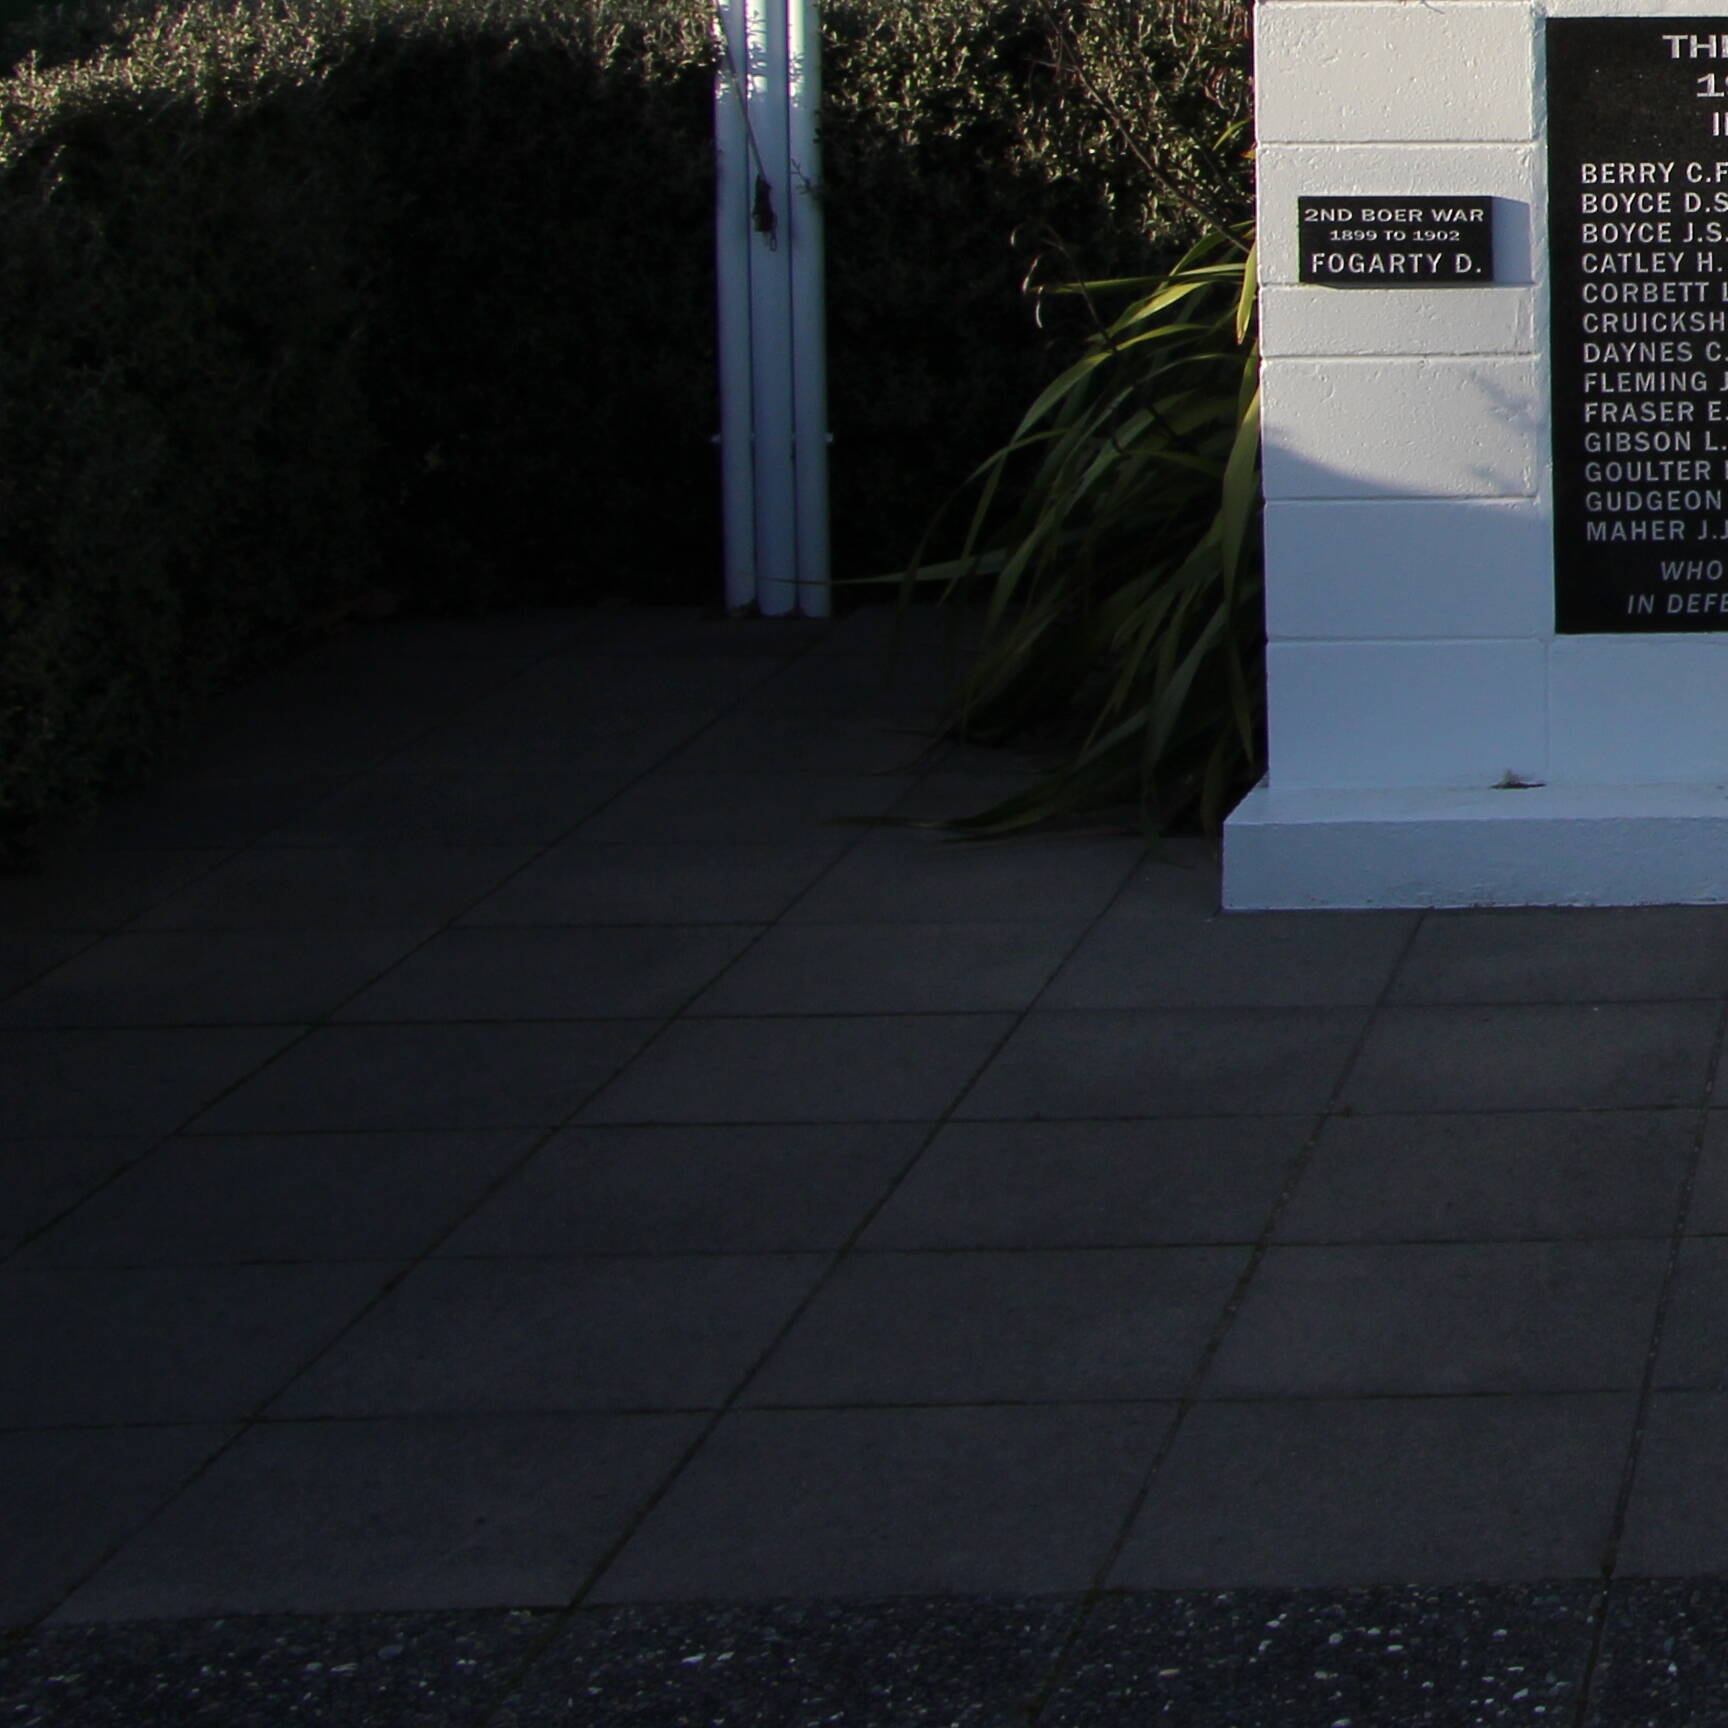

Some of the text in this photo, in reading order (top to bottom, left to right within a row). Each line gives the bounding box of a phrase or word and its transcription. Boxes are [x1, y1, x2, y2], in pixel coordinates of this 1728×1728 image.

[1581, 161, 1675, 184] BERRY
[1582, 191, 1671, 214] BOYCE
[1304, 208, 1484, 223] 2ND BOER WAR
[1330, 229, 1460, 241] 1899 TO 1902
[1582, 222, 1672, 244] BOYCE
[1312, 252, 1482, 274] FOGARTY D.
[1582, 251, 1723, 274] CATLEY H.
[1582, 281, 1710, 304] CORBETT
[1583, 341, 1693, 363] DAYNES
[1584, 371, 1707, 393] FLEMING
[1584, 401, 1695, 423] FRASER
[1584, 430, 1727, 453] GIBSON L.
[1585, 460, 1711, 482] GOULTER
[1585, 489, 1722, 512] GUDGEON
[1586, 519, 1685, 541] MAHER
[1660, 559, 1723, 581] WHO
[1627, 594, 1655, 614] IN
